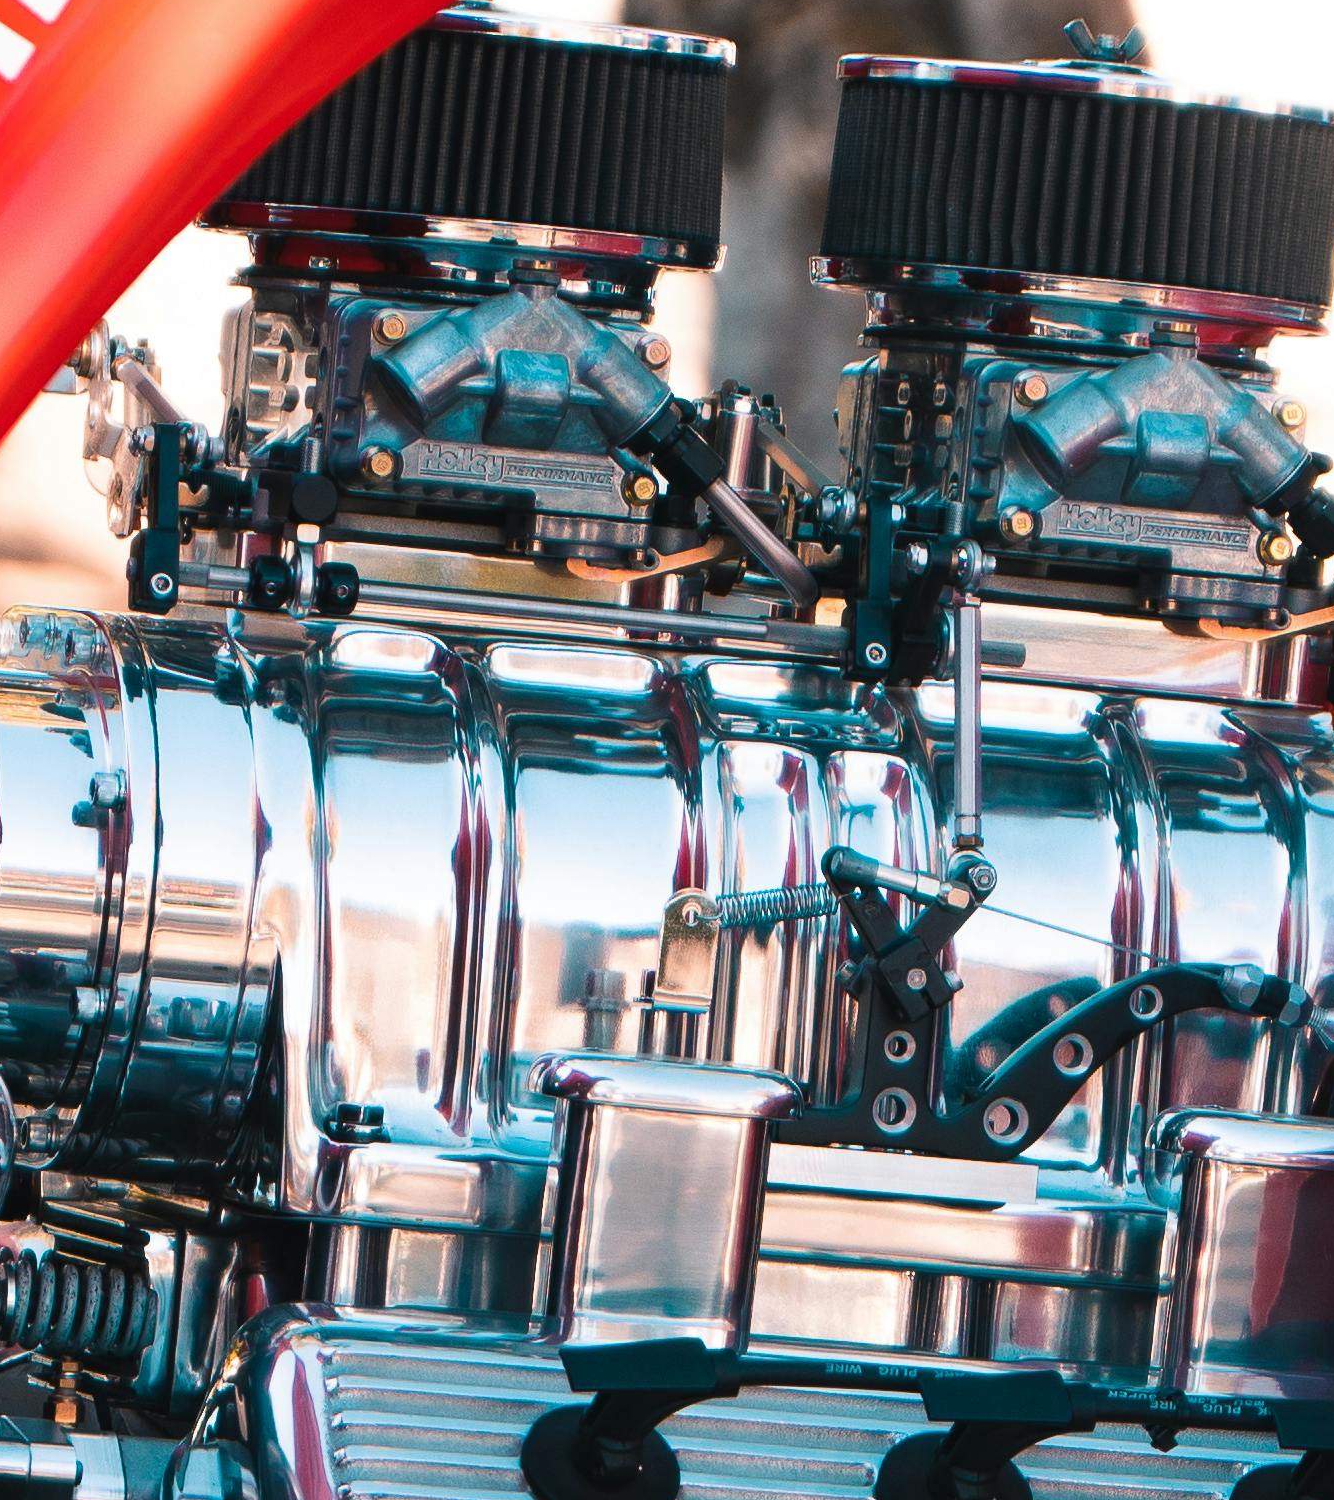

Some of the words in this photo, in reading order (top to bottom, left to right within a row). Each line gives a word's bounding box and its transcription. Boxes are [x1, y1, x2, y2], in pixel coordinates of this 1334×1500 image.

[420, 442, 505, 483] Holley
[506, 465, 613, 485] PERFORMANCE
[1059, 503, 1142, 543] Holley
[1144, 525, 1249, 546] PERFORMANCE
[825, 1362, 862, 1375] WIRE
[878, 1364, 918, 1377] PLUG
[1202, 1402, 1242, 1415] PLUG
